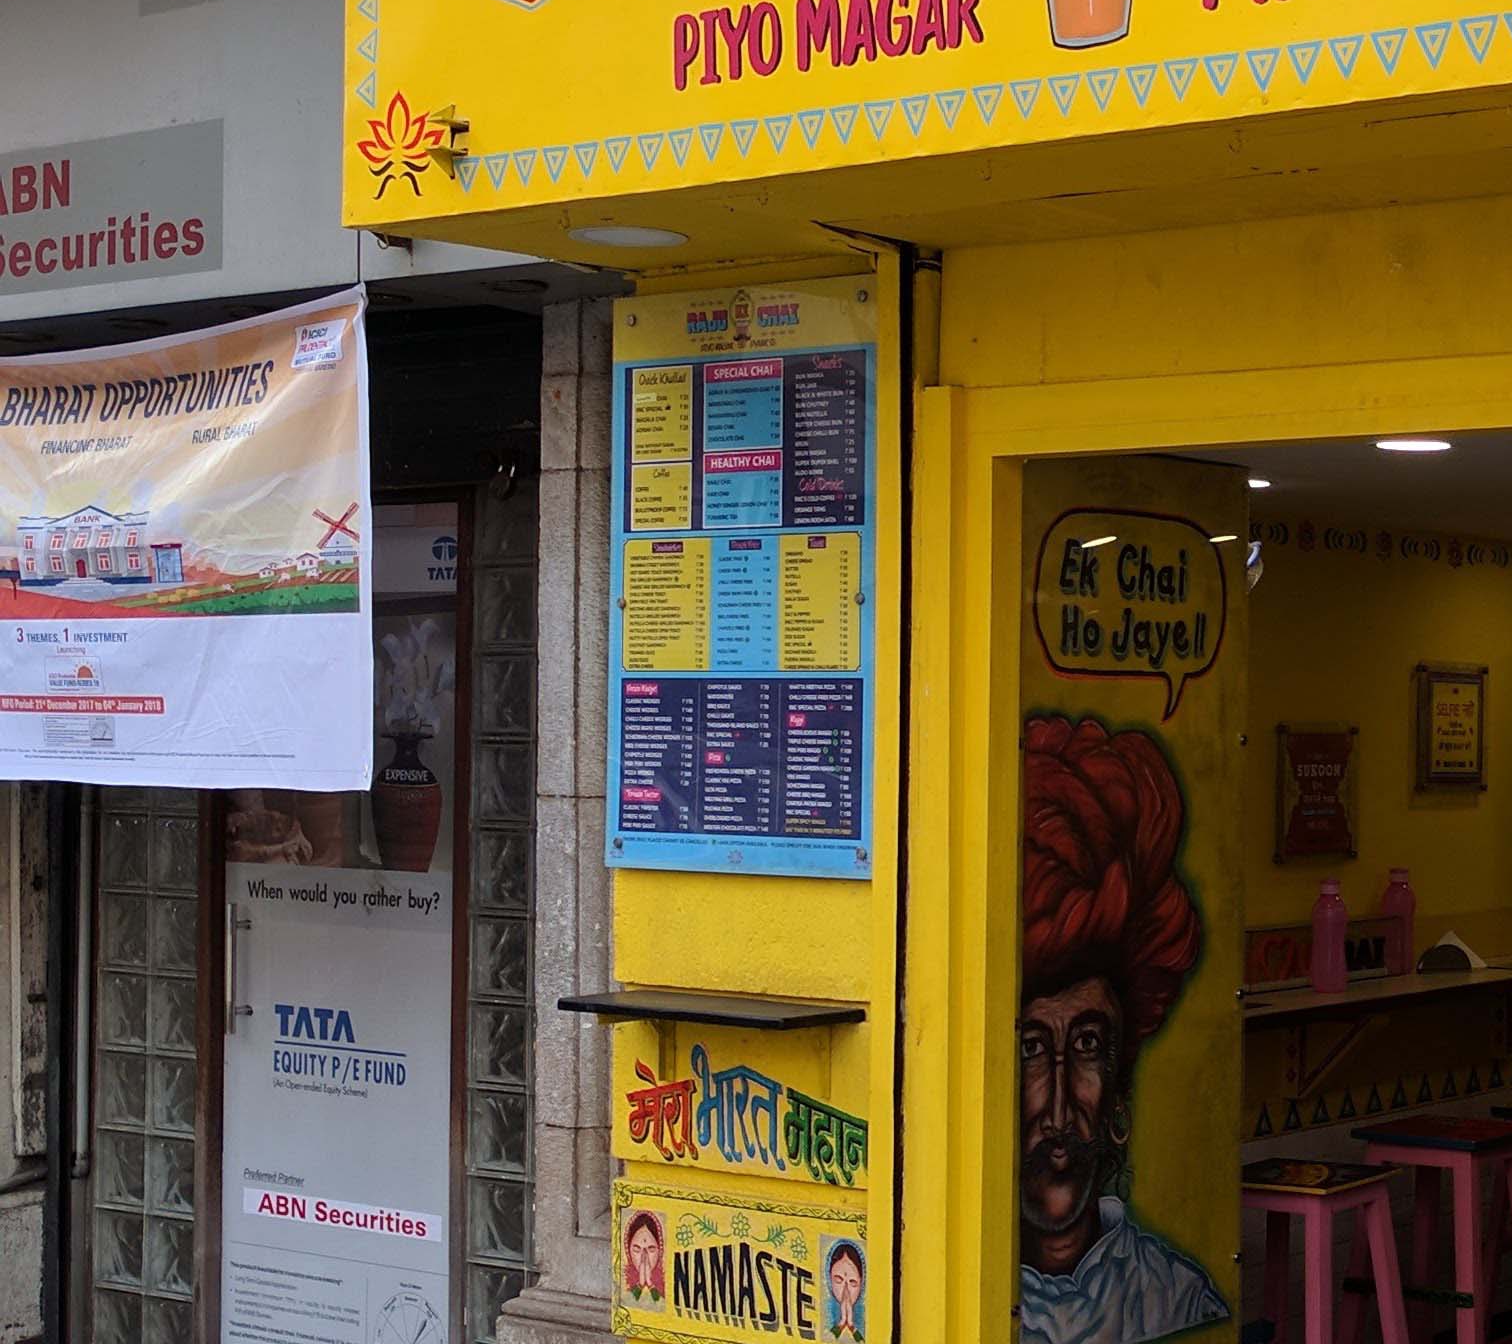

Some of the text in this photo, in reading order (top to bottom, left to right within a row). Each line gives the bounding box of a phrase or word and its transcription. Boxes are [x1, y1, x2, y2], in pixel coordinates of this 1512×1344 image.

[673, 1, 783, 91] PIYO
[0, 212, 204, 278] ecurities
[687, 309, 728, 334] RAJU
[714, 364, 773, 379] SPECIAL CHAI
[0, 360, 274, 426] BHARAT OPPORTUNITIES
[41, 435, 132, 455] FINANCING BHARAT
[192, 429, 221, 444] RURAL
[711, 456, 775, 468] HEALTHY CHAI
[1059, 538, 1188, 604] Ek Chai
[16, 628, 24, 643] 3
[63, 628, 69, 642] 1
[74, 632, 128, 642] INVESTMENT
[1060, 604, 1103, 657] Ho
[385, 768, 428, 781] EXPENSIVE
[248, 880, 440, 914] When would you rather buy?
[274, 1004, 355, 1043] TATA
[273, 1050, 406, 1086] EQUITY P/E FUND
[626, 1058, 698, 1160] मेरा
[692, 1042, 785, 1171] भारत
[258, 1193, 426, 1237] ABN Securities
[674, 1243, 816, 1340] NAMASTE
